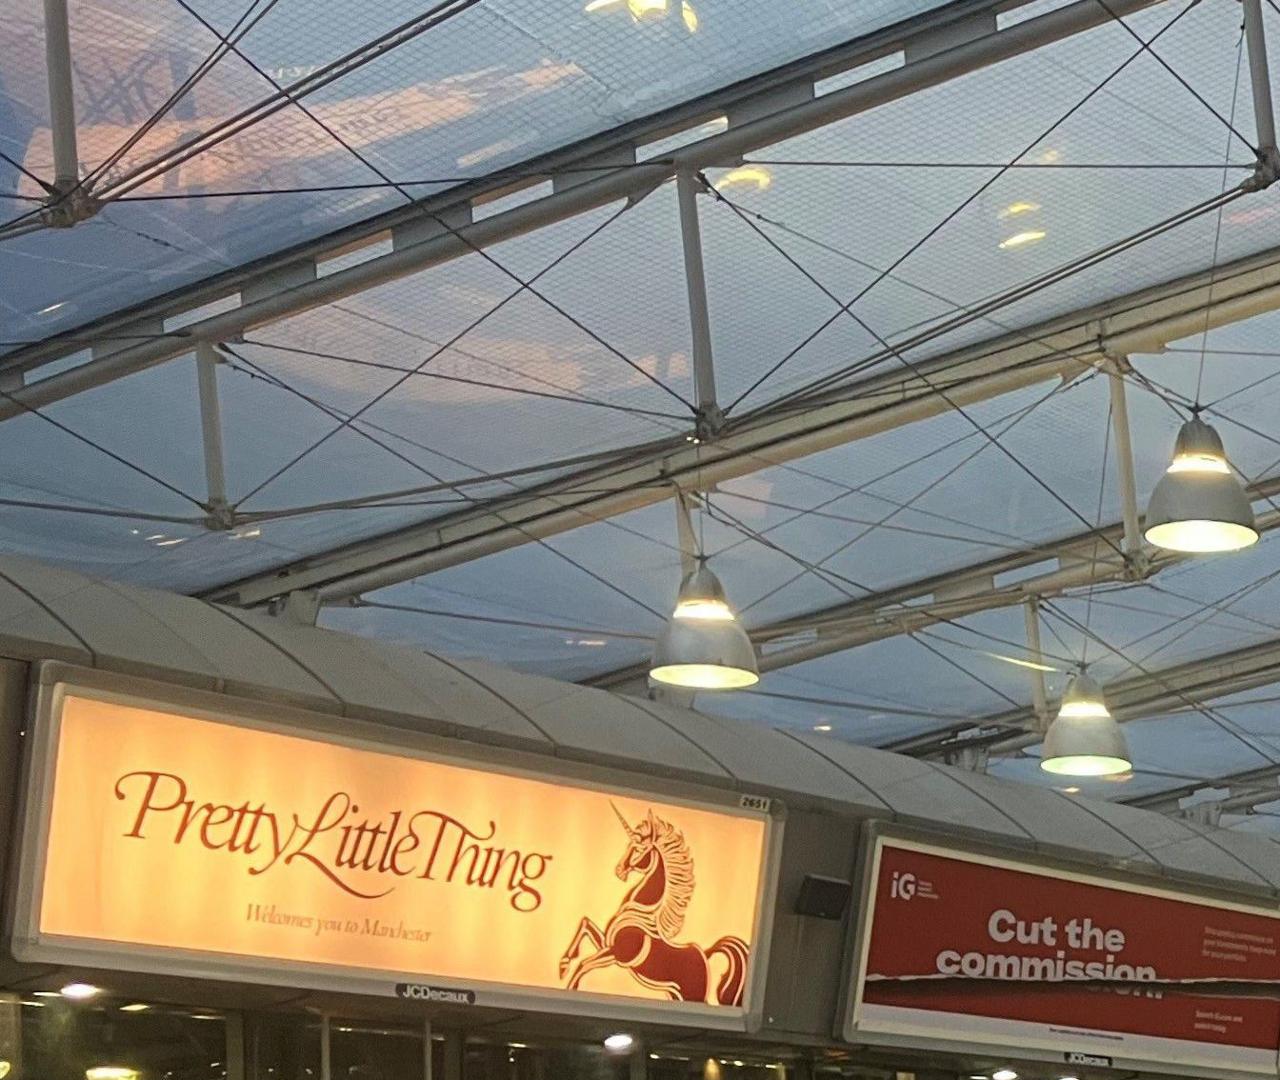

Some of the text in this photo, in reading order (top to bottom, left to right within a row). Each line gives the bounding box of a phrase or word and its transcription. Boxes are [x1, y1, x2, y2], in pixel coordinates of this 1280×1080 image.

[315, 918, 341, 937] you
[344, 920, 358, 934] to
[988, 909, 1126, 952] Cut the
